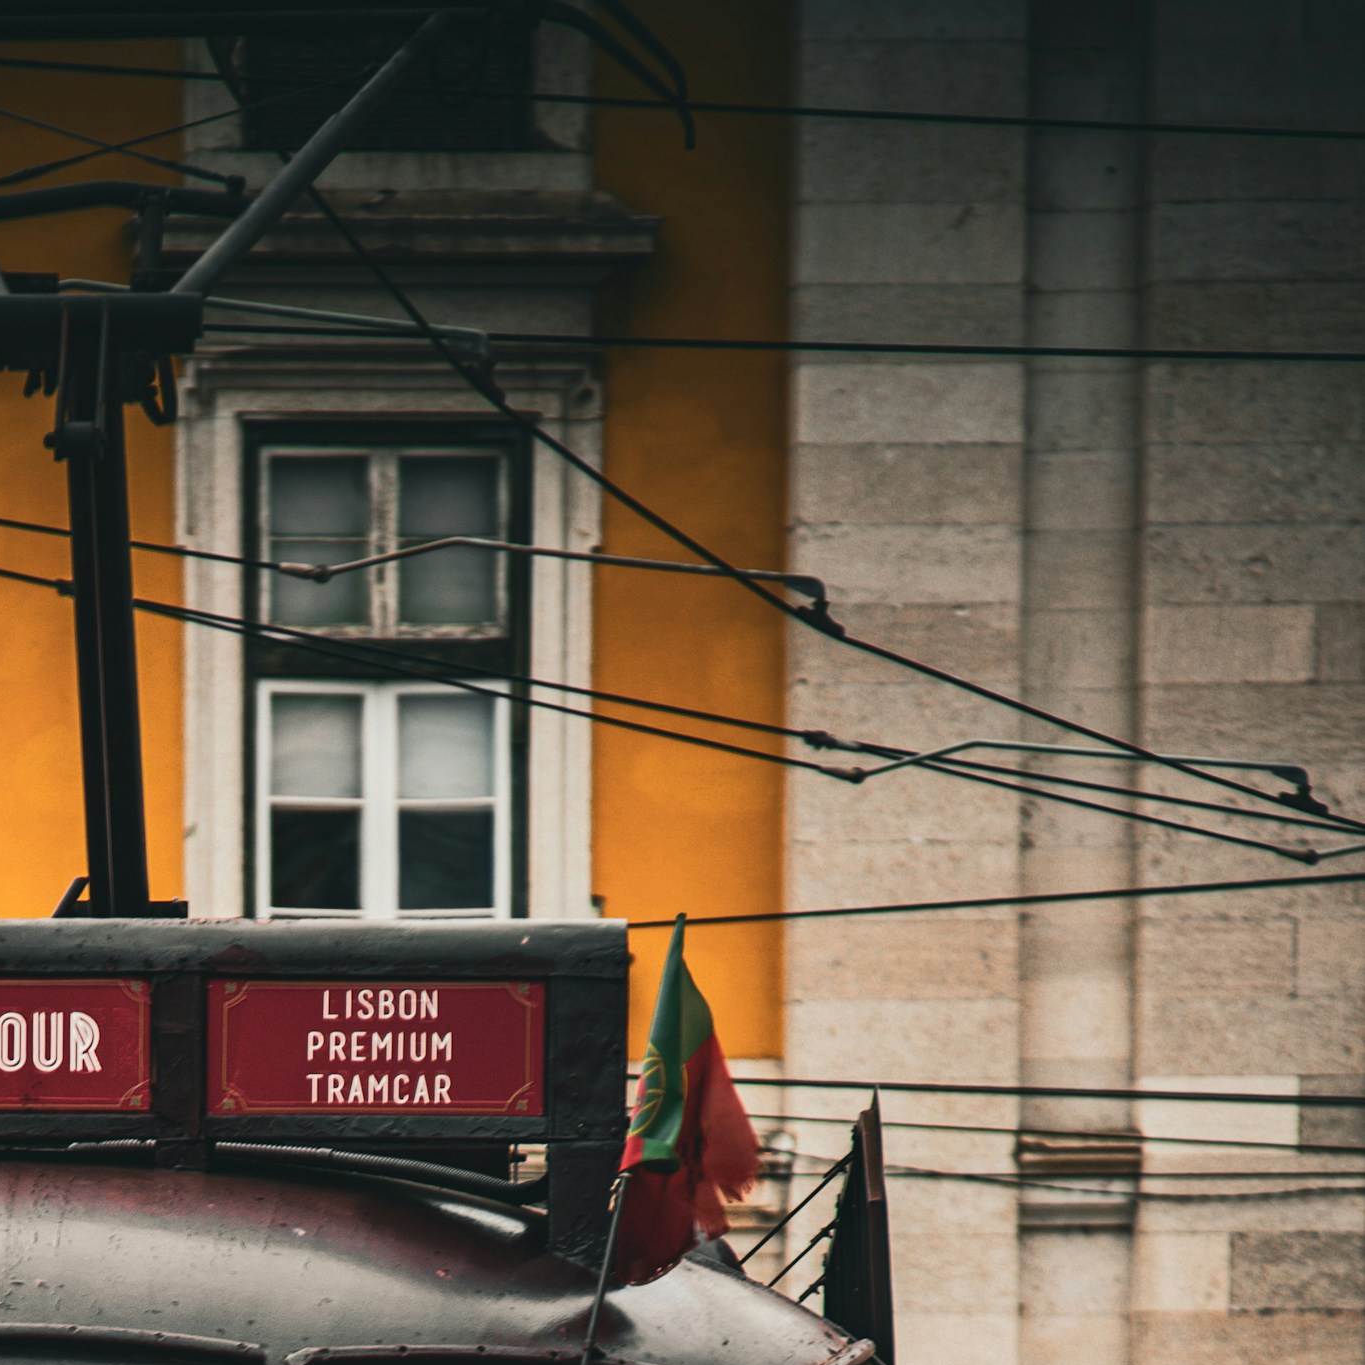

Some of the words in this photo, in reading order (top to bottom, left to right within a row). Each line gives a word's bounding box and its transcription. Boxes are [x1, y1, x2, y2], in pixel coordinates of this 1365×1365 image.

[322, 989, 439, 1020] LISBON
[307, 1031, 453, 1062] PREMIUM
[305, 1073, 452, 1104] TRAMCAR
